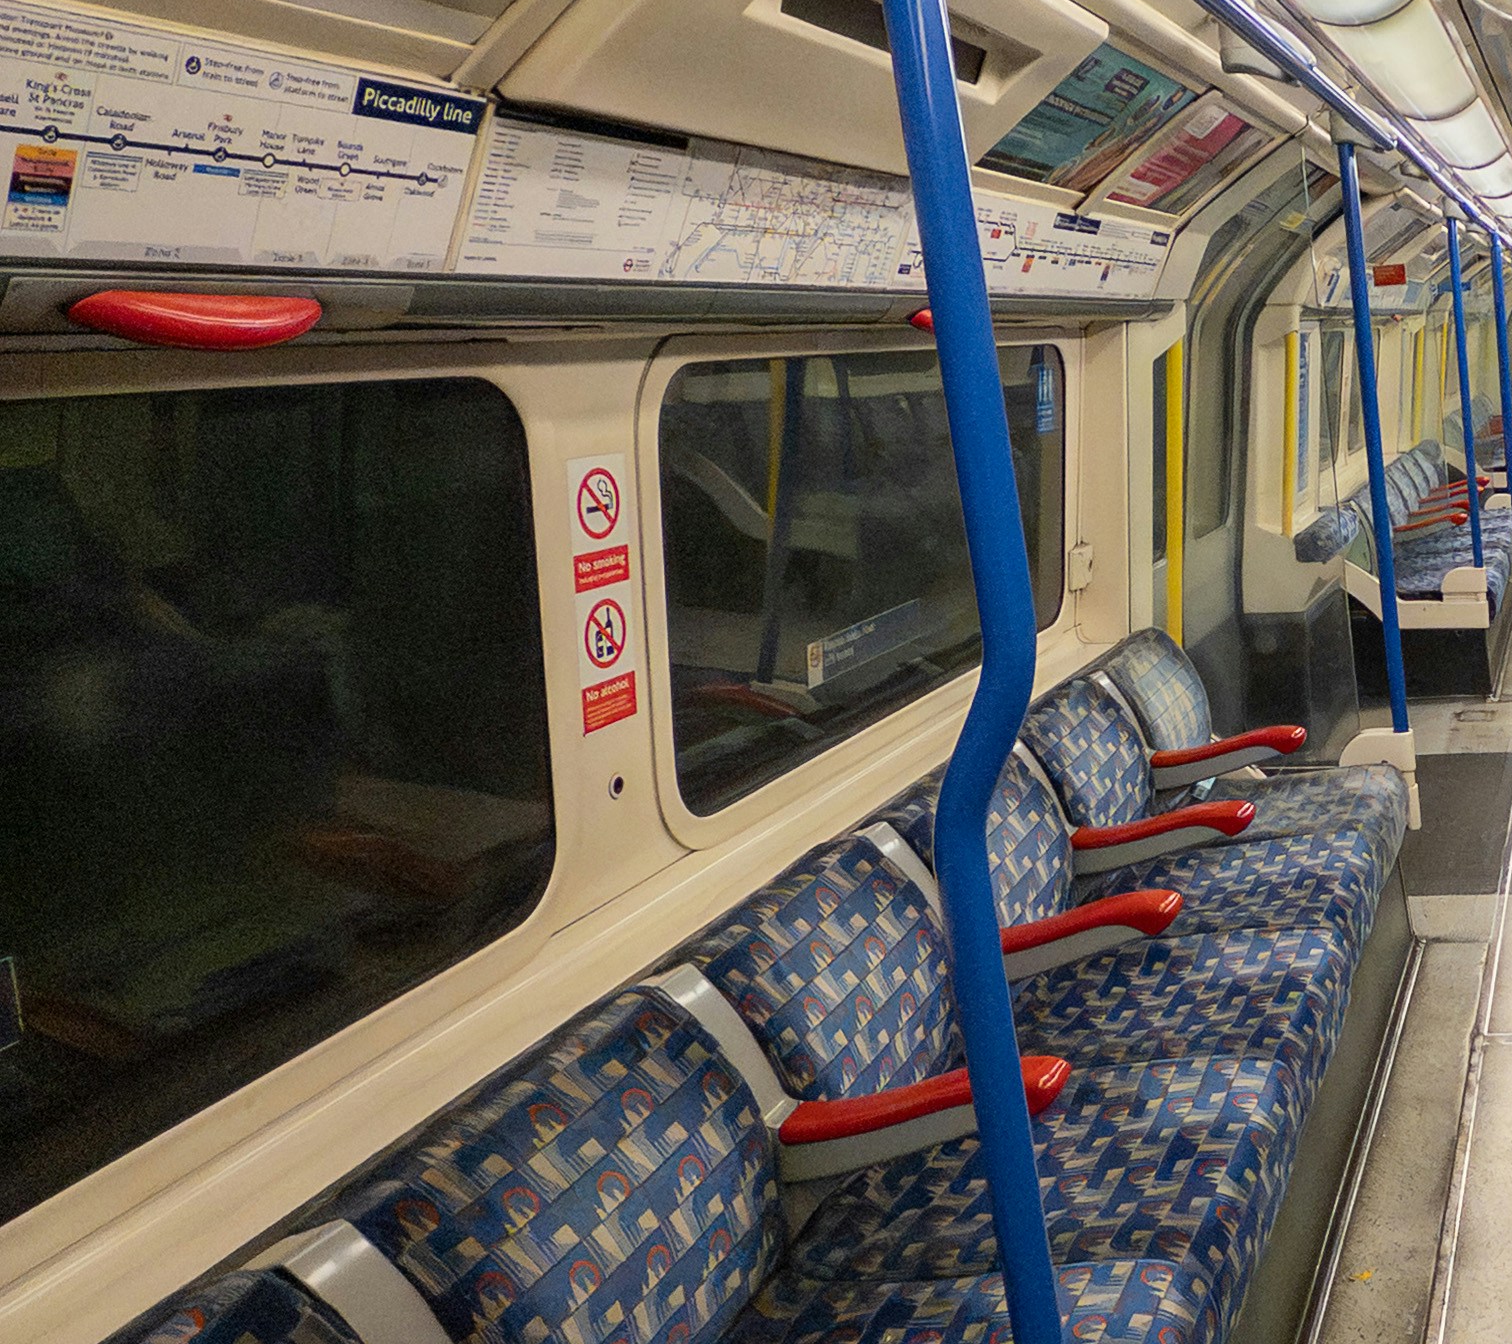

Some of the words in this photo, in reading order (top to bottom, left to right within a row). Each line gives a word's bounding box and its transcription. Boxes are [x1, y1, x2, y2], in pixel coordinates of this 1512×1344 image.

[363, 87, 442, 122] Piccadilly
[443, 102, 473, 124] line
[579, 561, 592, 574] No
[593, 554, 626, 570] smoking
[586, 690, 600, 702] No
[600, 678, 630, 697] alcohol
